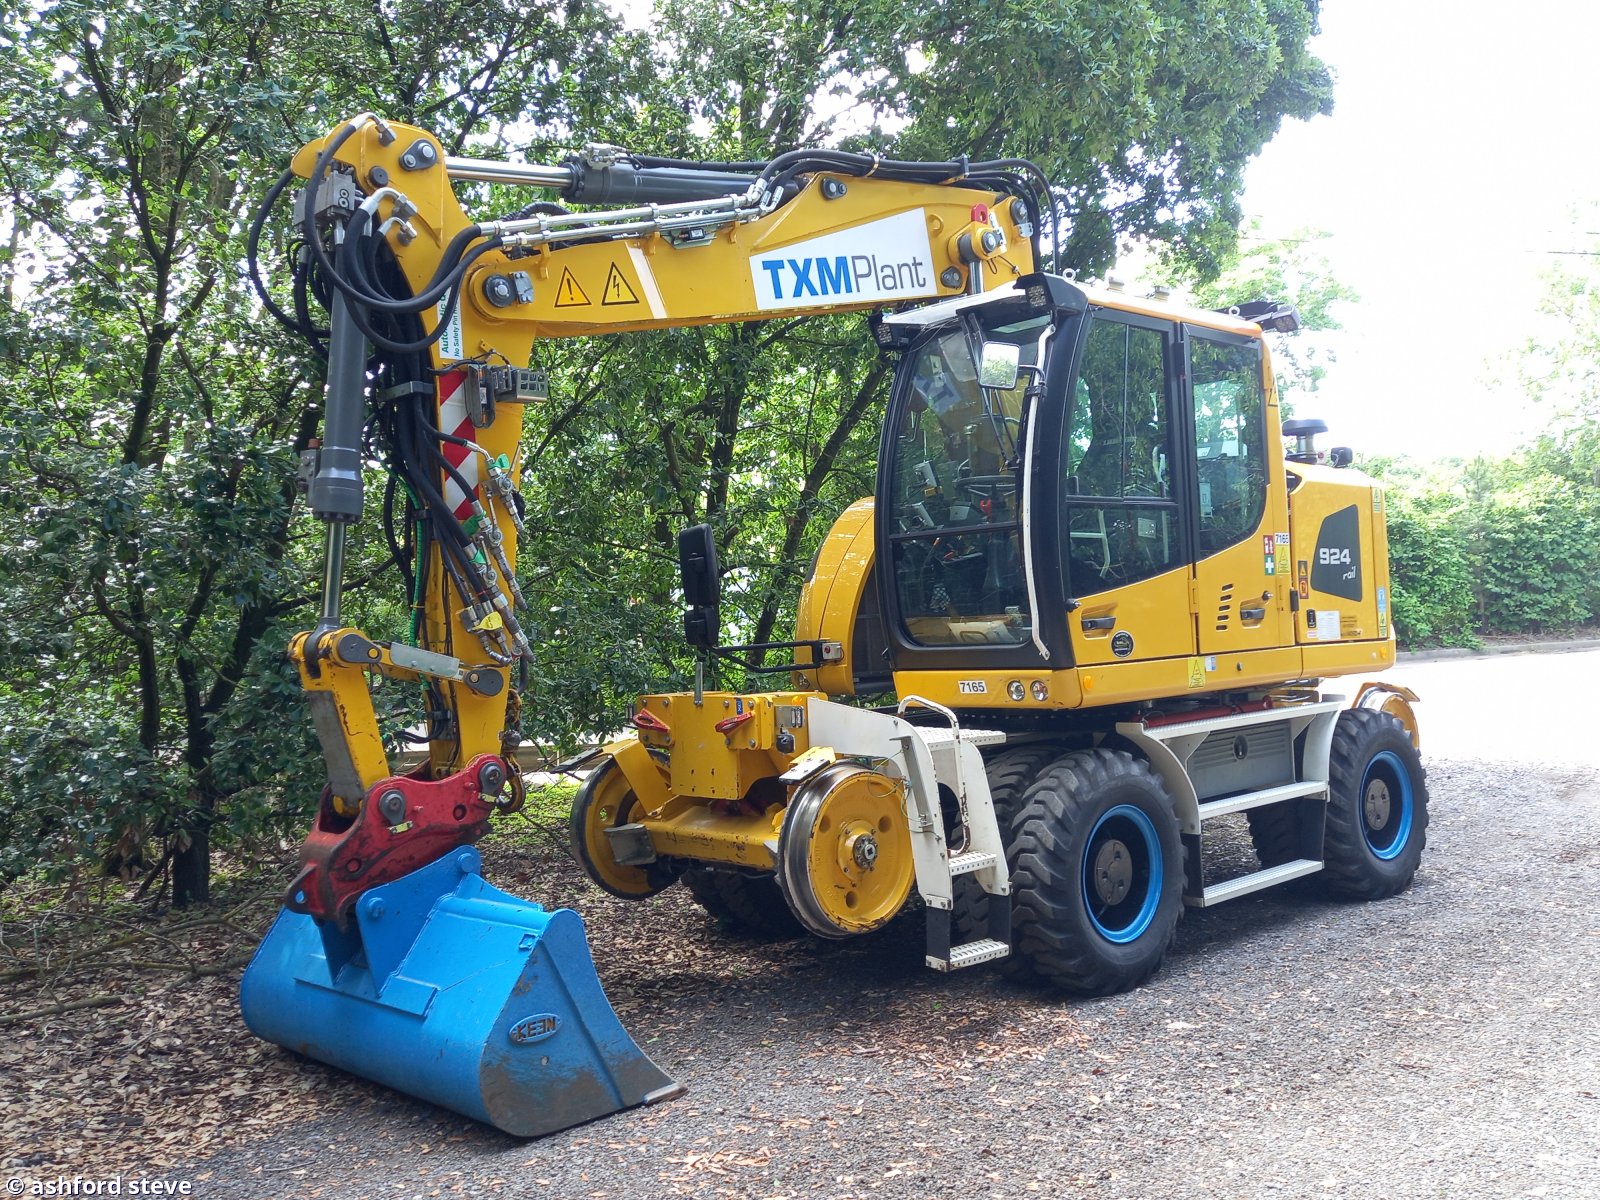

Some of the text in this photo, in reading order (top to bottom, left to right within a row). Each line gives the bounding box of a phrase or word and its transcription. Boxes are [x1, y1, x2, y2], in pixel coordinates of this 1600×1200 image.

[1319, 547, 1351, 565] 924
[1342, 565, 1356, 580] rail
[960, 682, 985, 693] 7165
[516, 1016, 556, 1040] KEEN
